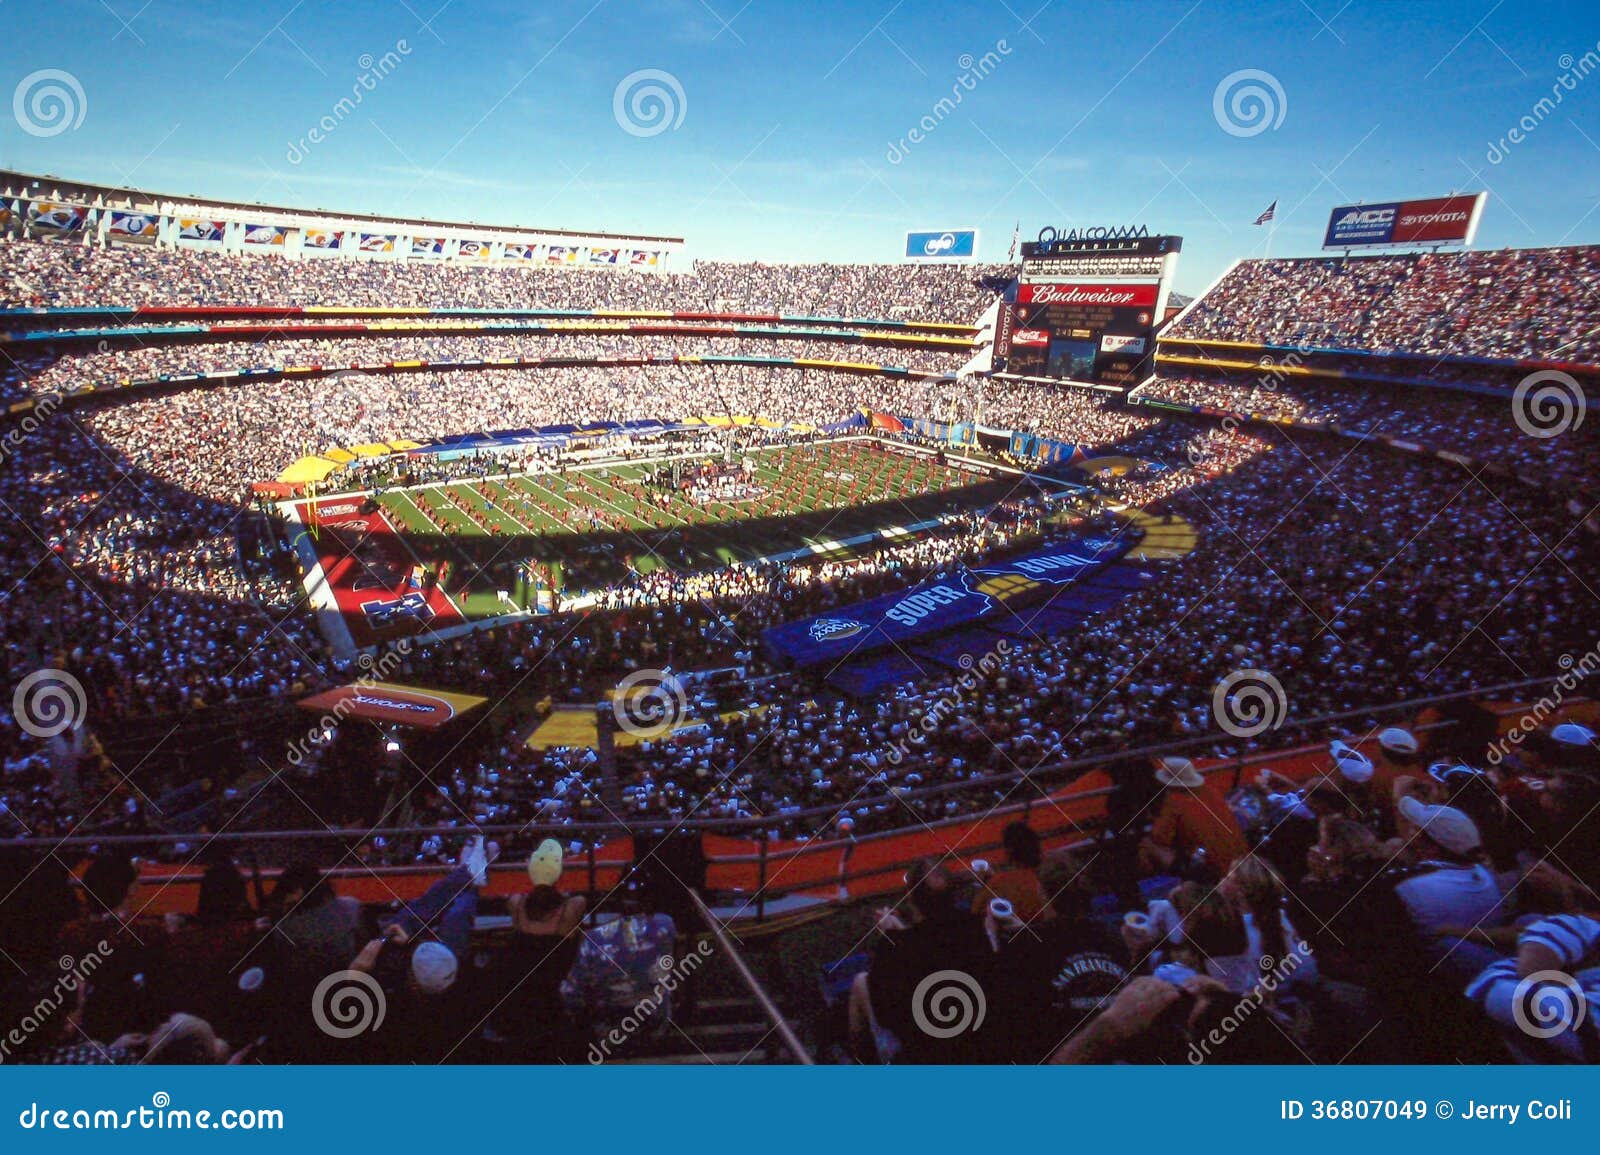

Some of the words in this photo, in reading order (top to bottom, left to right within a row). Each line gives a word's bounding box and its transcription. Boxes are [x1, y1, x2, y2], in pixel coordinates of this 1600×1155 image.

[1412, 211, 1467, 224] TOYOTA
[1058, 241, 1140, 251] STADIUM
[1031, 285, 1135, 303] Budweiser
[1001, 305, 1012, 340] TOYOTA
[886, 585, 967, 626] SUPER
[1012, 554, 1101, 573] BOWL
